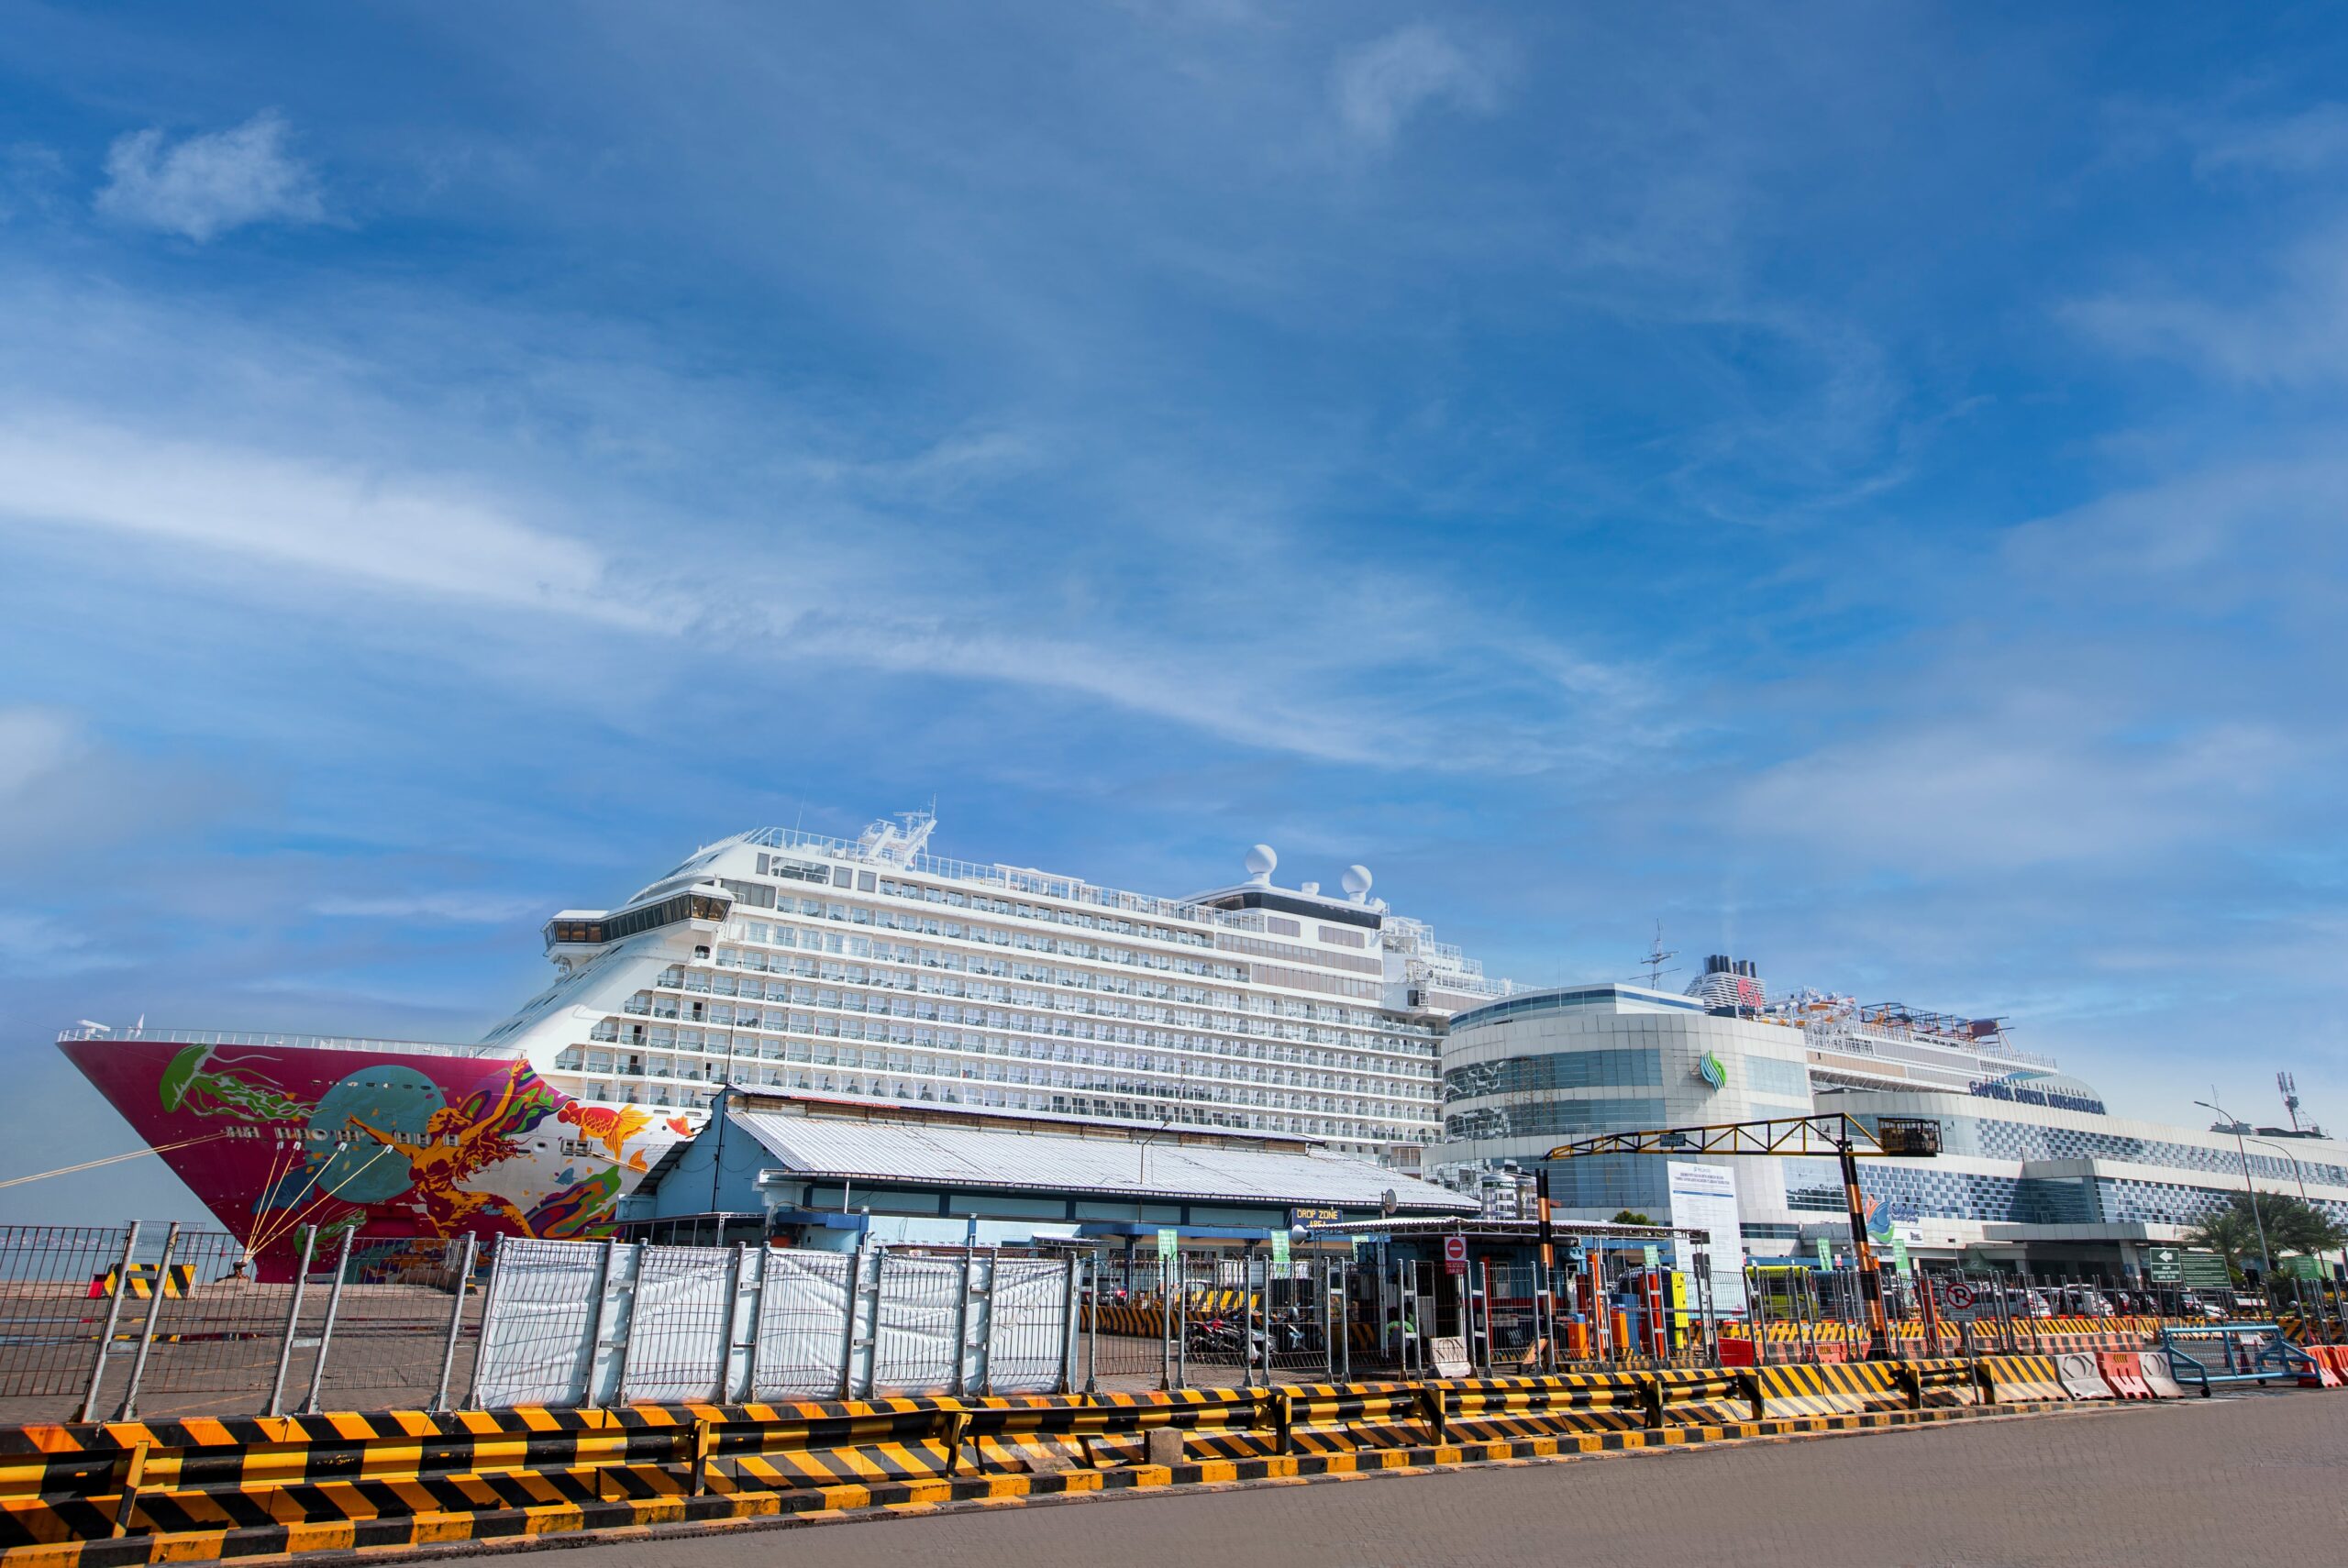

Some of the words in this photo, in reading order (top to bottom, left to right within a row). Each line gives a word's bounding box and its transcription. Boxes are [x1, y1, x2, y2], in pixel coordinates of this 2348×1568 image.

[1969, 1080, 2014, 1102] GAPURA
[2015, 1088, 2047, 1107] SURYA
[2047, 1092, 2106, 1115] NUSANTARA
[1297, 1209, 1316, 1219] DROP
[1319, 1210, 1338, 1220] ZONE
